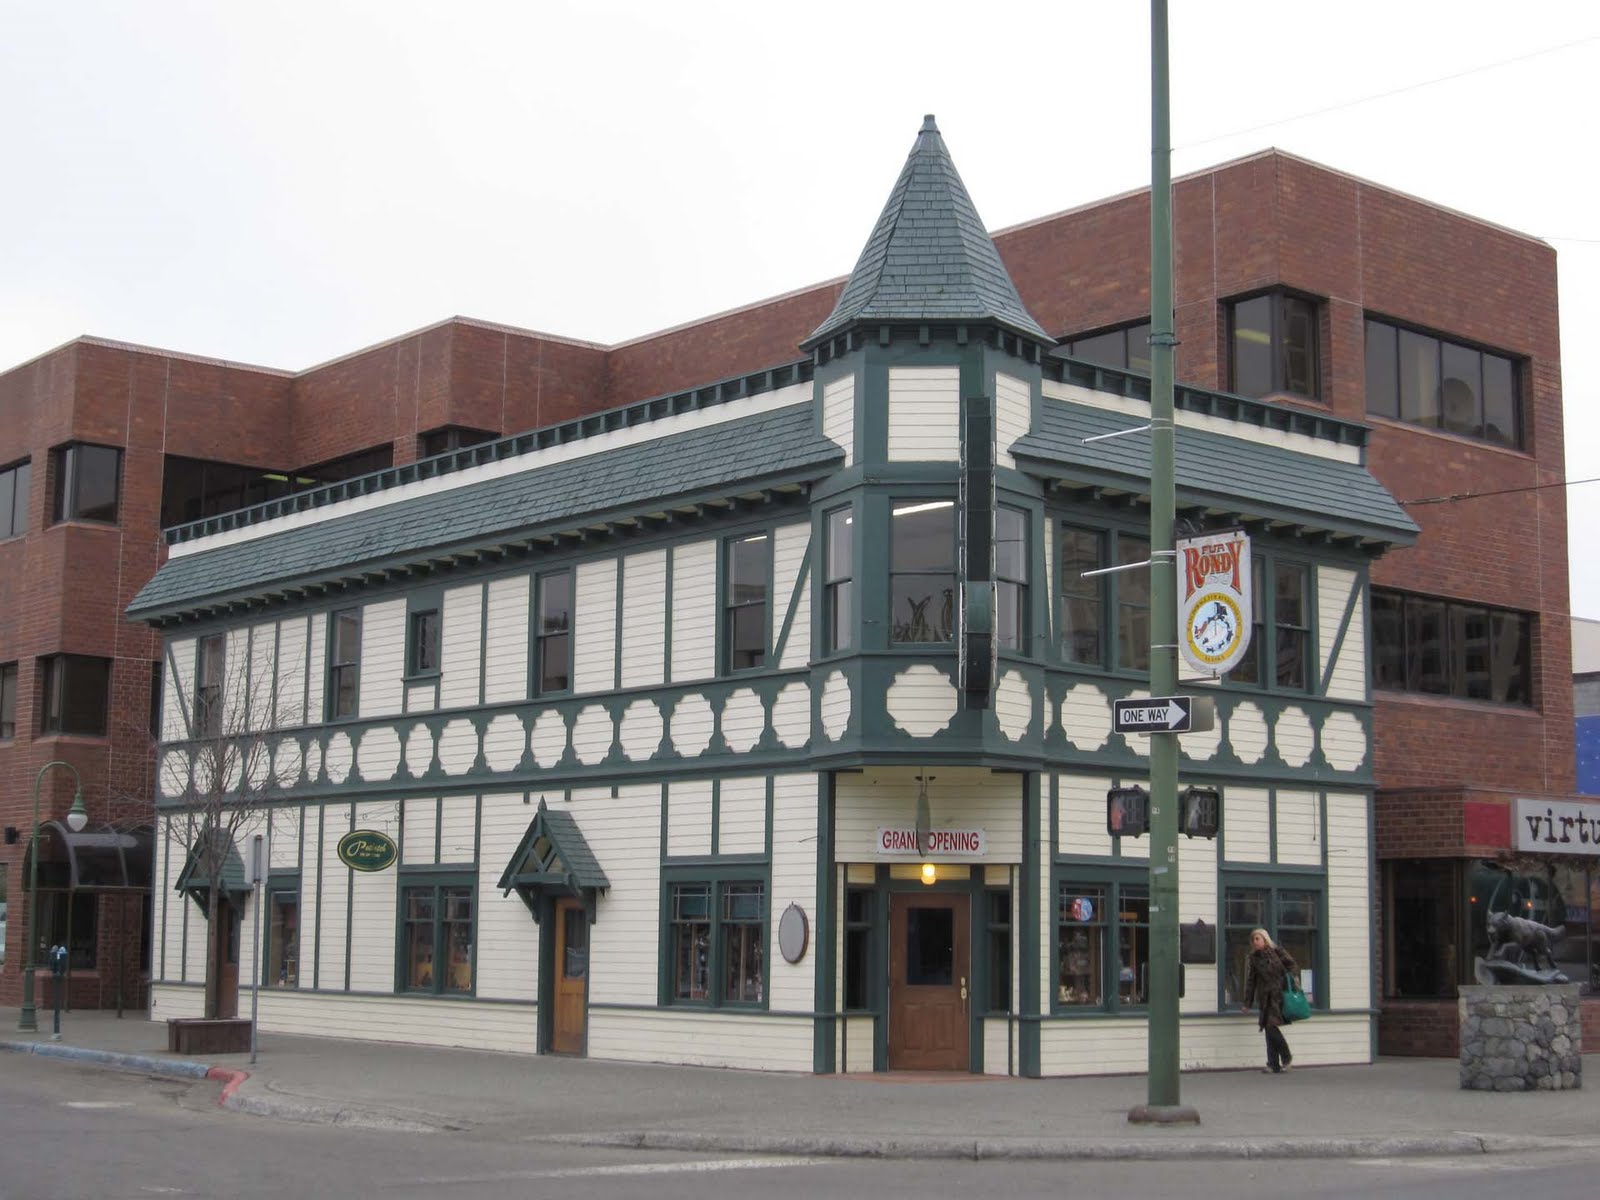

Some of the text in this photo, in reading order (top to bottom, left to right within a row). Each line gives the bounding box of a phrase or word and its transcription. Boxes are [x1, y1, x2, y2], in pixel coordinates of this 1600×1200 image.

[1201, 544, 1225, 555] FUR
[1183, 540, 1244, 604] RONDY
[1123, 708, 1169, 723] ONE WAY
[927, 831, 980, 851] OPENING
